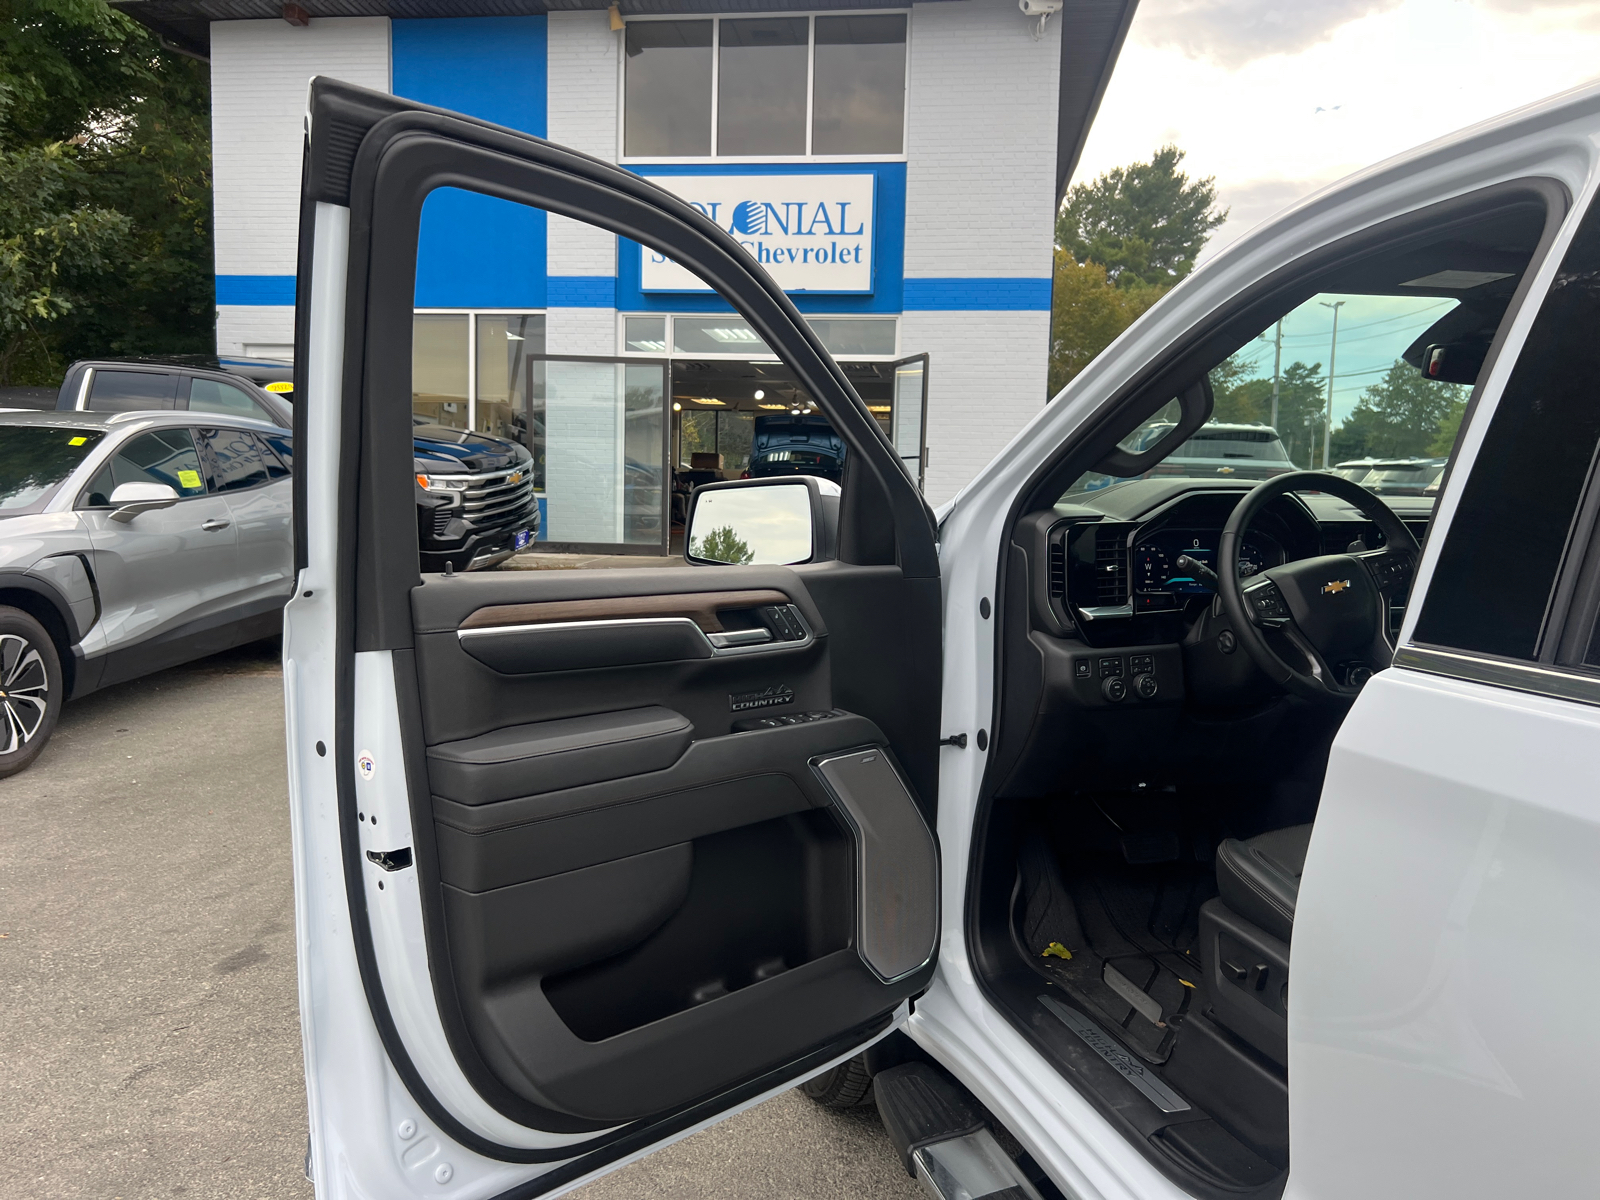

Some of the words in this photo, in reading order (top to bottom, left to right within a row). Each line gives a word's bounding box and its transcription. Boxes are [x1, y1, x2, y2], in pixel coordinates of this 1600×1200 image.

[732, 694, 793, 711] COUNTRY
[1078, 1029, 1137, 1079] COUNTRY
[1085, 1028, 1117, 1054] HIGH
